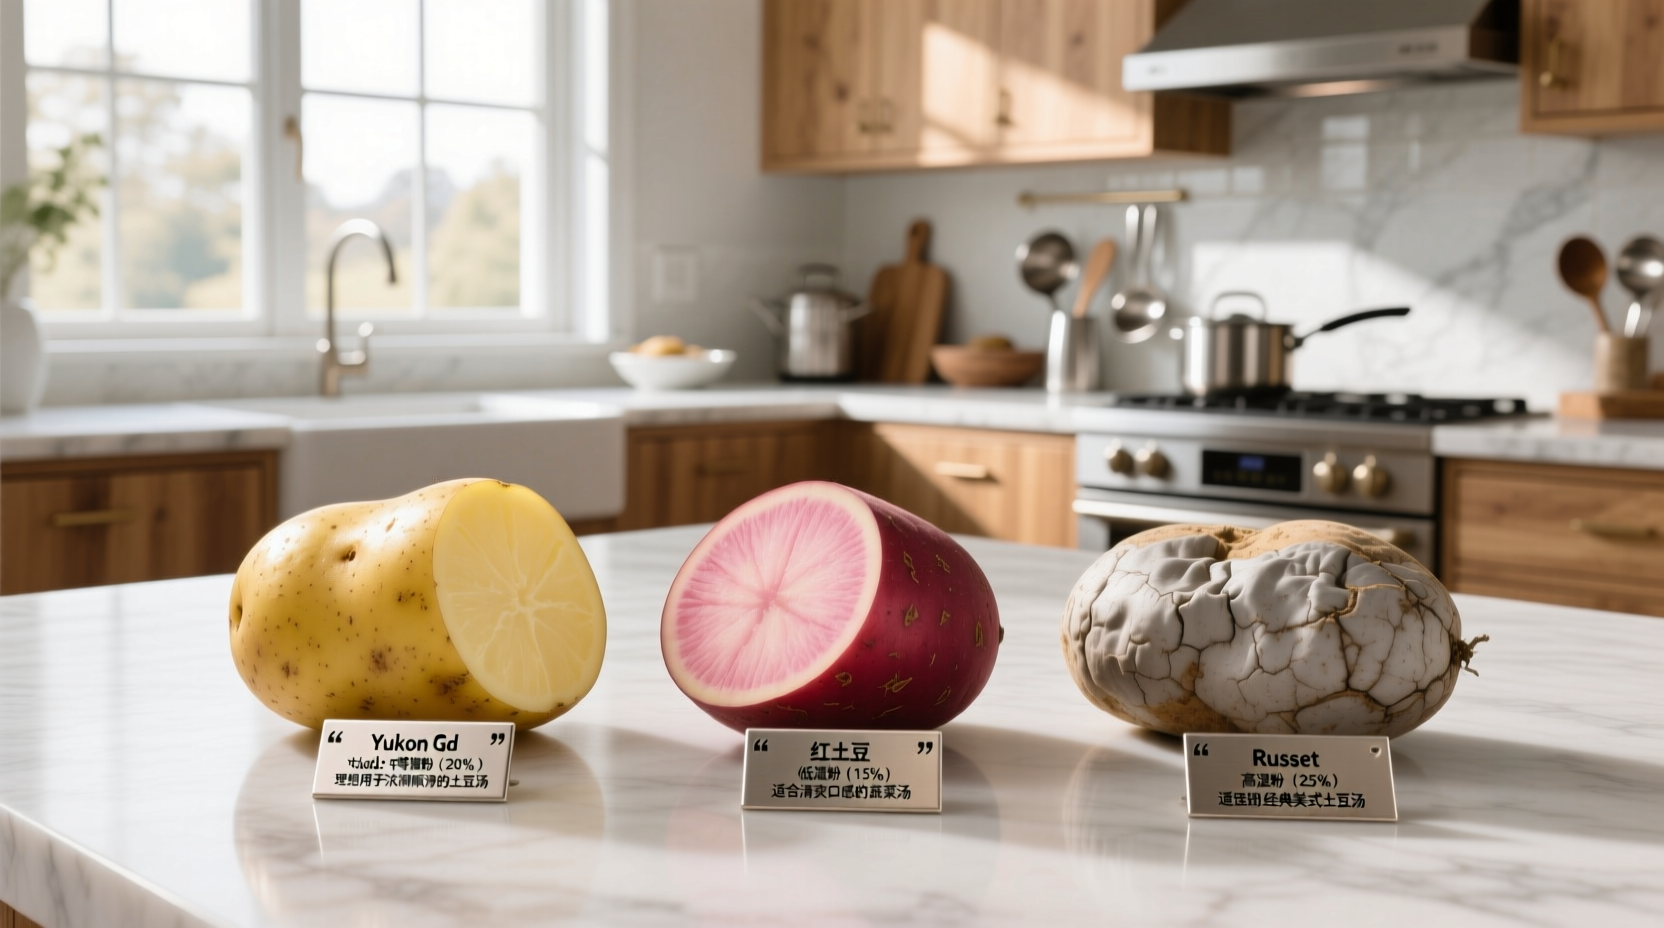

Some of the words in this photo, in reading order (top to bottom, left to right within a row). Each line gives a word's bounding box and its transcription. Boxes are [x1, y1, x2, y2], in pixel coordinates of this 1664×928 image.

[372, 733, 428, 752] Yukon
[433, 734, 459, 752] Gd
[810, 741, 871, 762] 红土豆
[1252, 749, 1320, 768] Russet
